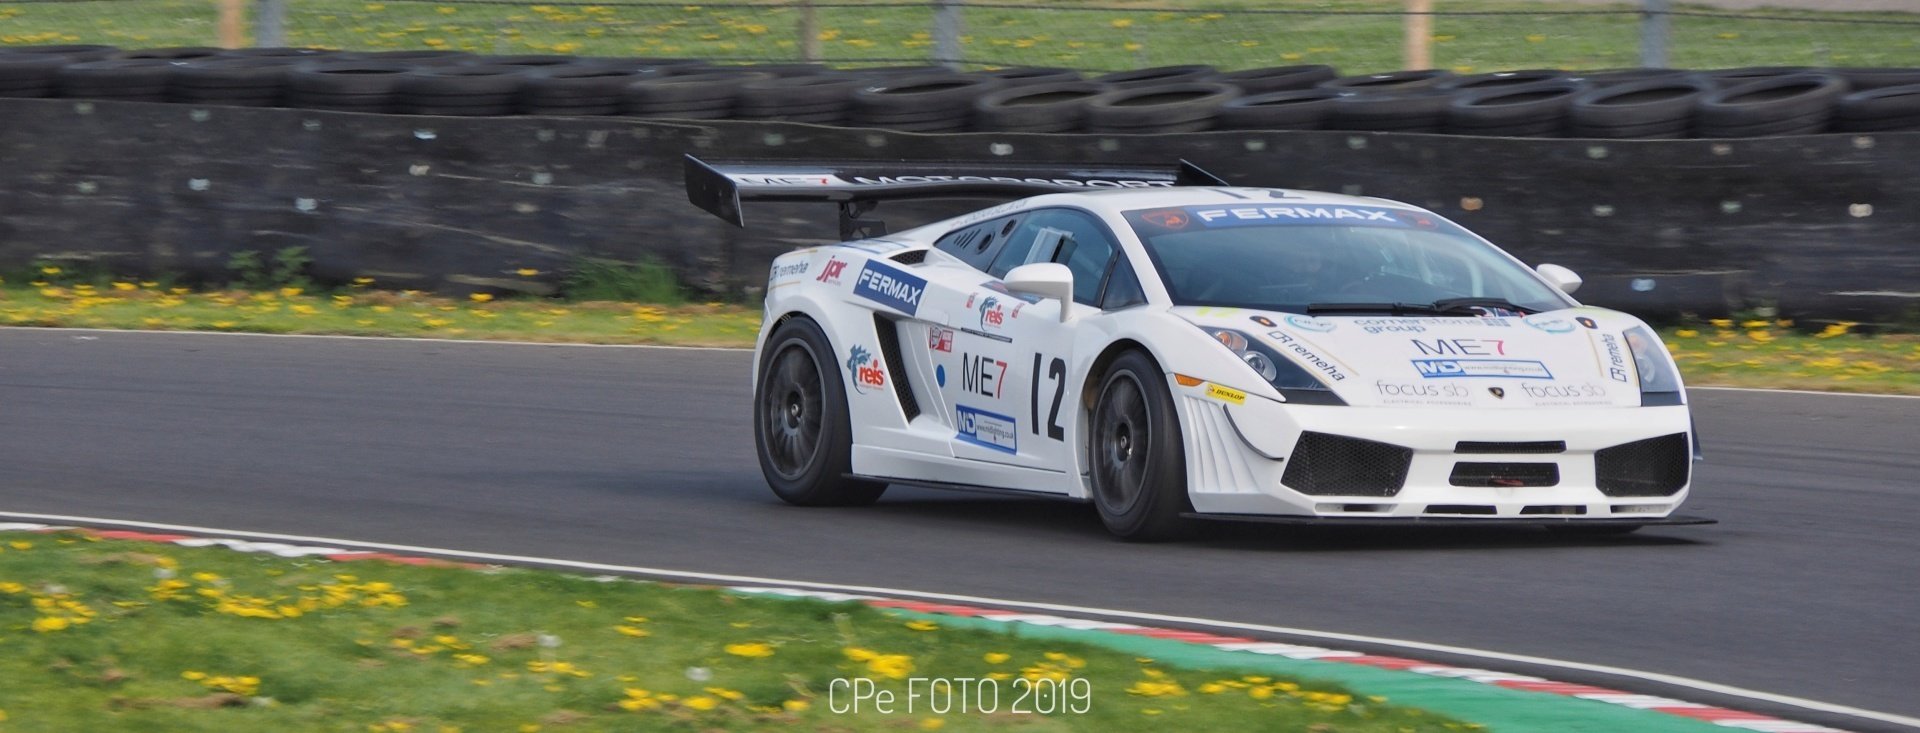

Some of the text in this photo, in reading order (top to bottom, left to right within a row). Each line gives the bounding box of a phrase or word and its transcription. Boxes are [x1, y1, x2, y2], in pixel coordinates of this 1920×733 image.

[1197, 206, 1397, 222] FERMAX
[815, 255, 848, 283] jpr
[858, 268, 922, 307] FERMAX
[984, 304, 1004, 326] reis
[1363, 325, 1427, 334] group
[1410, 339, 1505, 355] ME7
[1601, 333, 1624, 367] remeha
[859, 359, 885, 387] reis
[1290, 341, 1346, 382] remeha
[962, 352, 1008, 400] ME7
[1376, 379, 1470, 397] focus sb
[1031, 352, 1067, 443] 12
[1215, 389, 1246, 401] DUNLOP
[1521, 382, 1607, 399] focus sb
